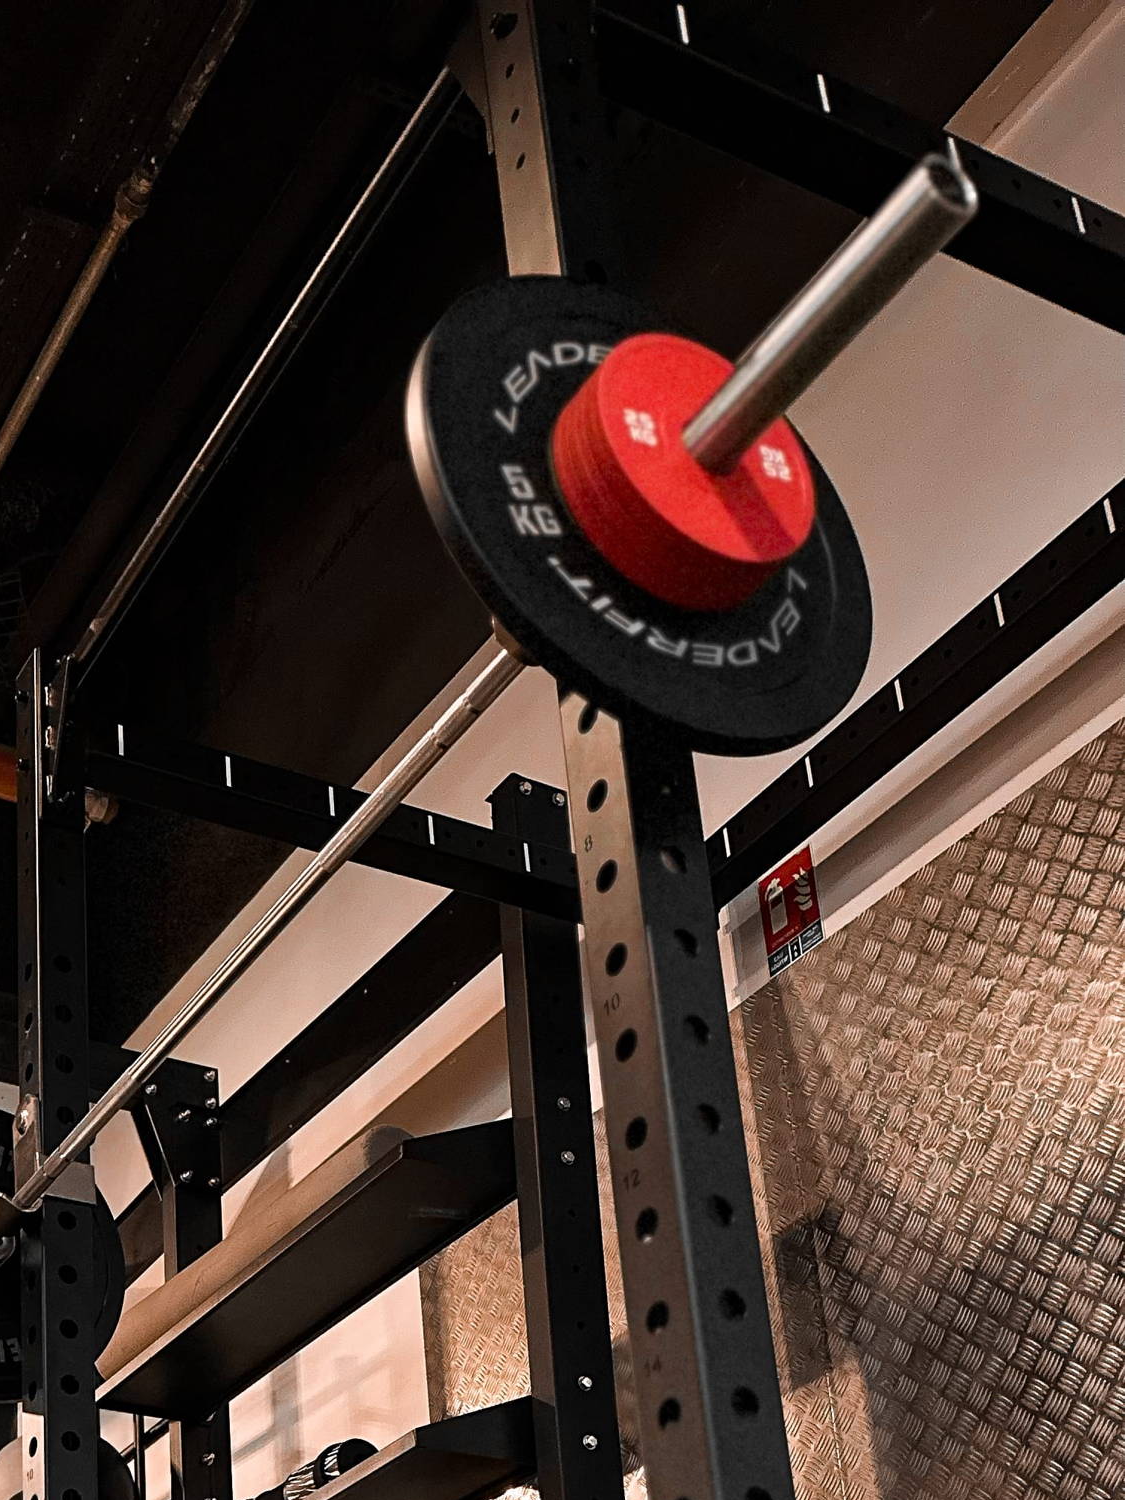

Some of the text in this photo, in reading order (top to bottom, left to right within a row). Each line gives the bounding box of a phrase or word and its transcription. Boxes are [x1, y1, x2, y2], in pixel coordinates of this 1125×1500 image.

[501, 464, 534, 501] 5
[508, 503, 562, 536] KG
[547, 556, 808, 668] LEADERFIT
[603, 992, 621, 1017] 10
[623, 1168, 641, 1193] 12
